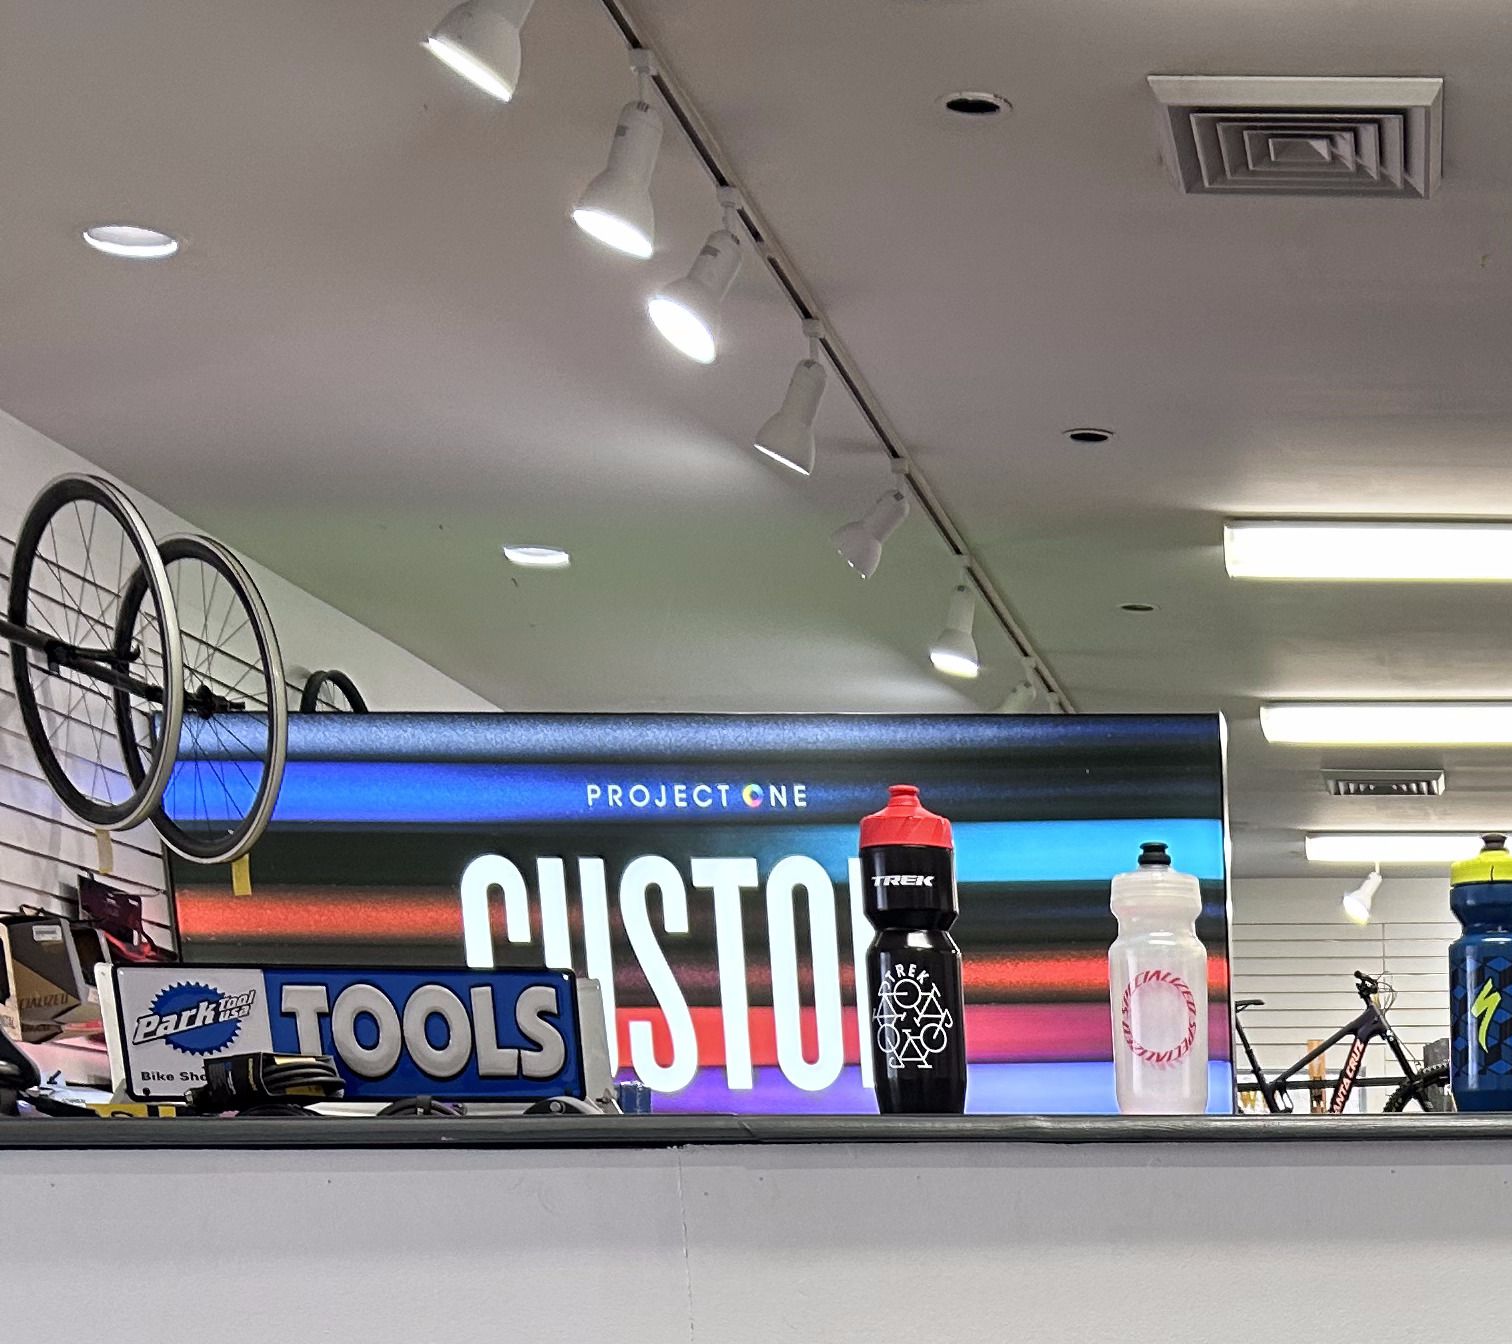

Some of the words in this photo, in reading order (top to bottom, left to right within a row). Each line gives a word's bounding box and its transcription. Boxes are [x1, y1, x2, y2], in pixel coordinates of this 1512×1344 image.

[586, 784, 730, 807] PROJECT
[742, 784, 807, 808] ONE
[871, 875, 935, 887] TREK
[885, 963, 930, 985] TREK
[218, 989, 256, 1011] Tool
[132, 1000, 217, 1046] Park
[219, 1003, 251, 1022] usa
[281, 983, 567, 1079] TOOLS
[141, 1071, 175, 1082] Bike
[1331, 1075, 1353, 1113] ANTA
[1346, 1039, 1365, 1079] CRUZ
